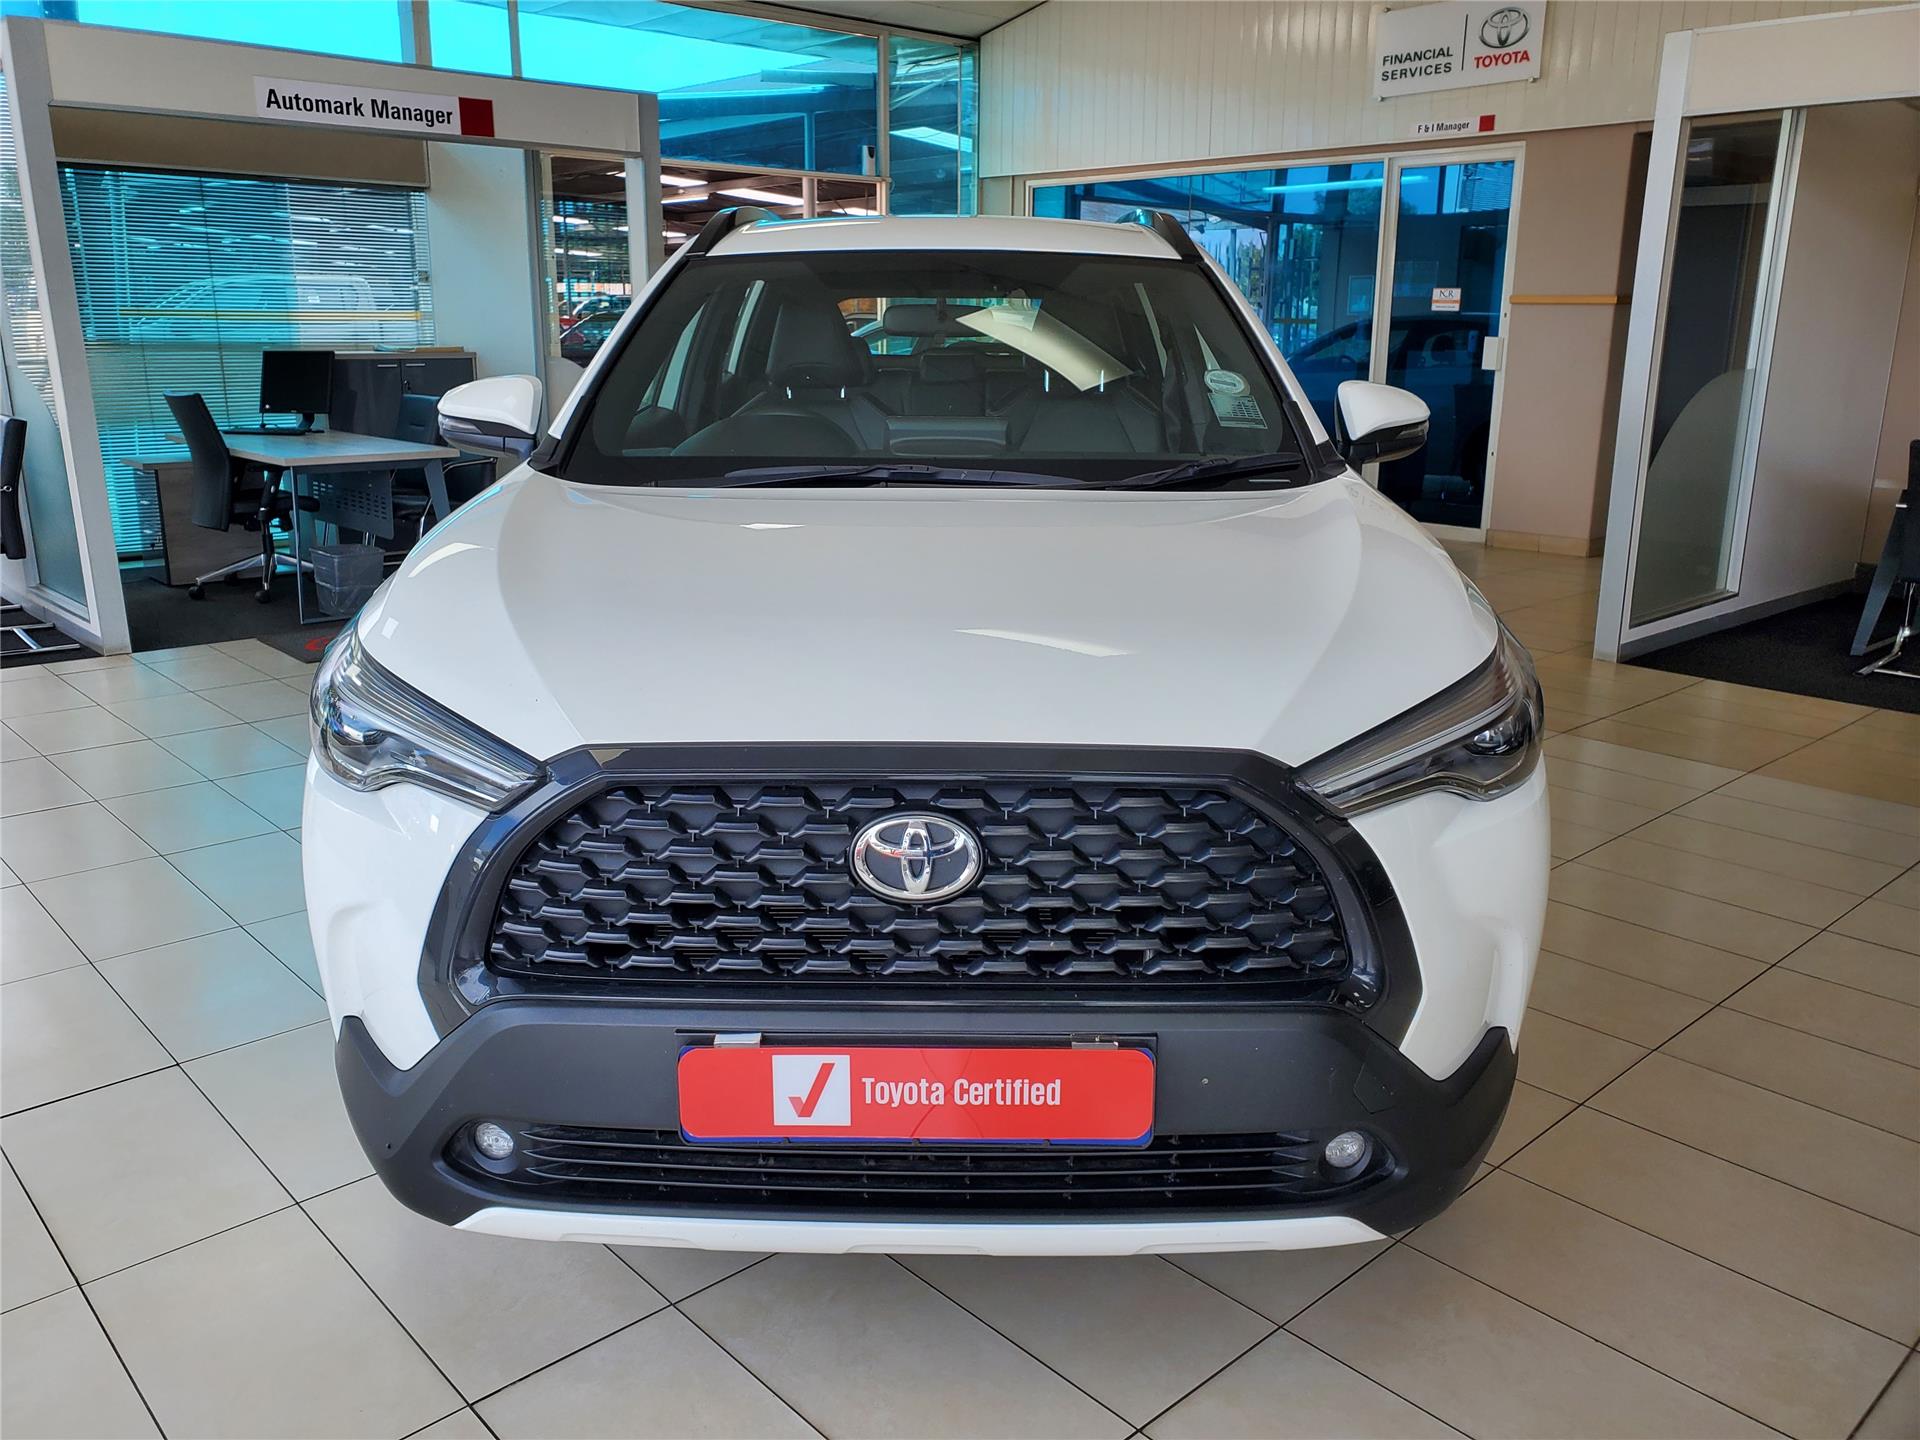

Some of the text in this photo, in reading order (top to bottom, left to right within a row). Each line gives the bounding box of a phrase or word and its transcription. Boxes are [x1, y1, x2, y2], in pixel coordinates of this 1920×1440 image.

[1382, 46, 1454, 66] FINANCIAL
[1474, 50, 1530, 69] TOYOTA
[1381, 62, 1452, 82] SERVICES
[266, 88, 453, 127] Automark Manager
[1417, 125, 1423, 134] F
[1424, 124, 1430, 133] &
[1436, 121, 1470, 133] Manager
[862, 1077, 1061, 1106] Toyota Certified
